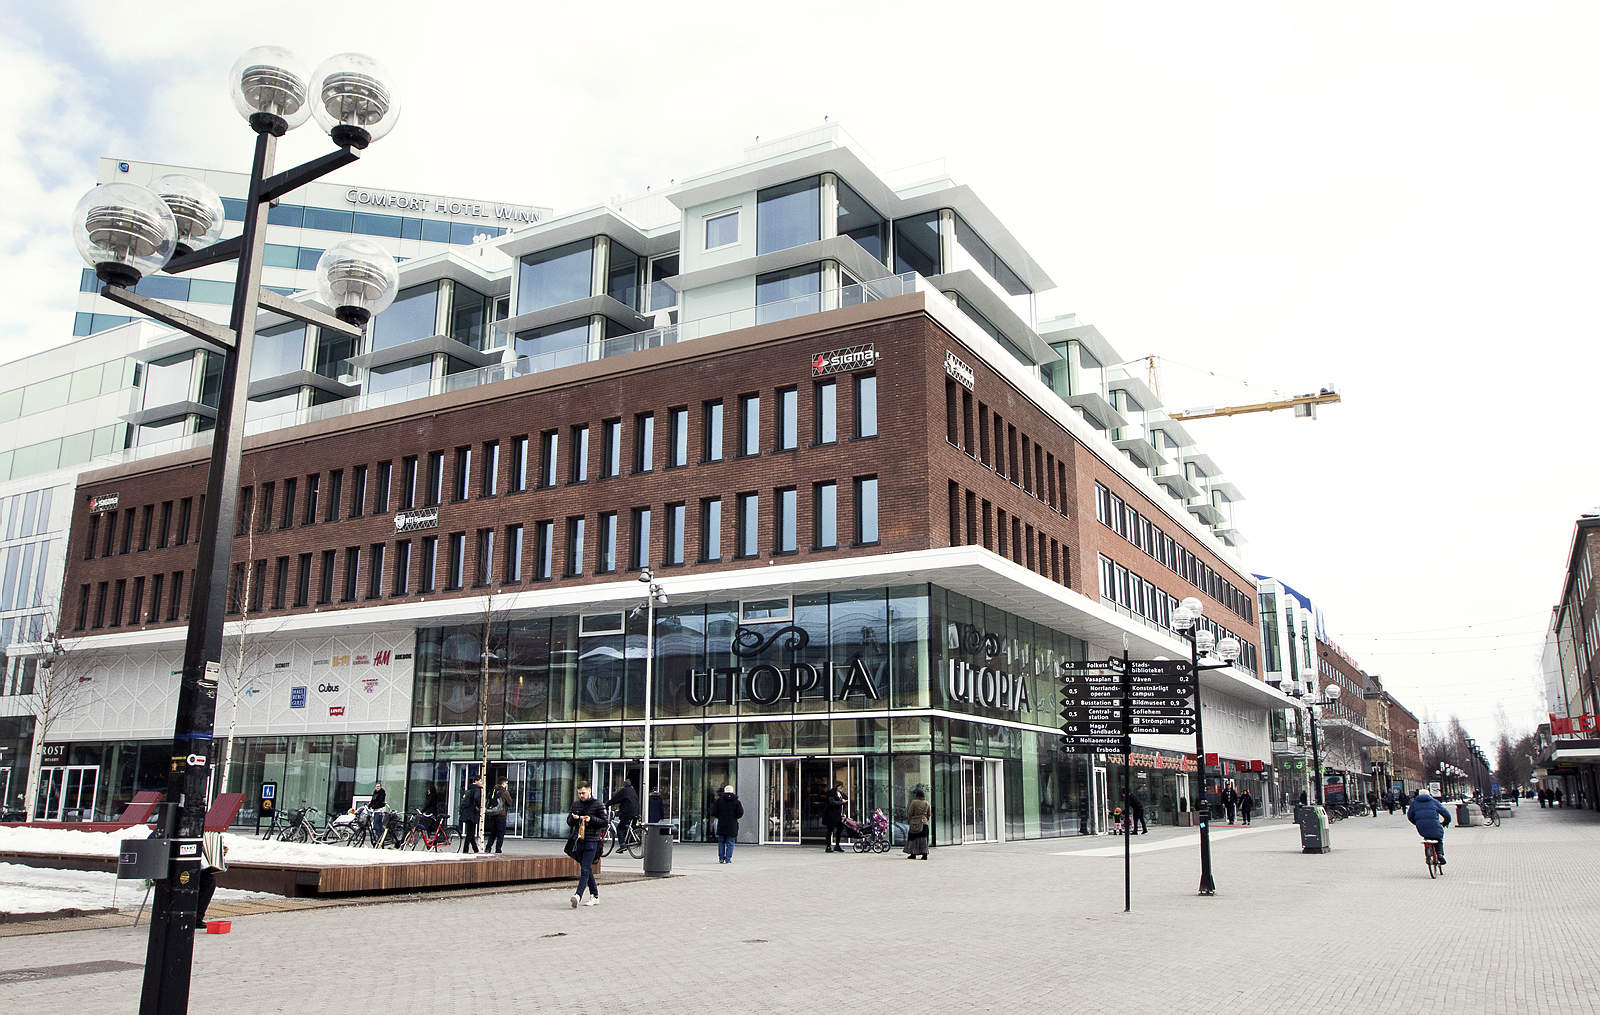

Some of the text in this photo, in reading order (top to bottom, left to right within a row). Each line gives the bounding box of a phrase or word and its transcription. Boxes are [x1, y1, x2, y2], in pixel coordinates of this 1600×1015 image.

[345, 188, 542, 224] COMFORT HOTEL WINN
[373, 649, 392, 667] H&M
[318, 682, 340, 693] Cubus
[685, 655, 880, 707] UTOPIA
[948, 658, 1030, 713] UTOPIA
